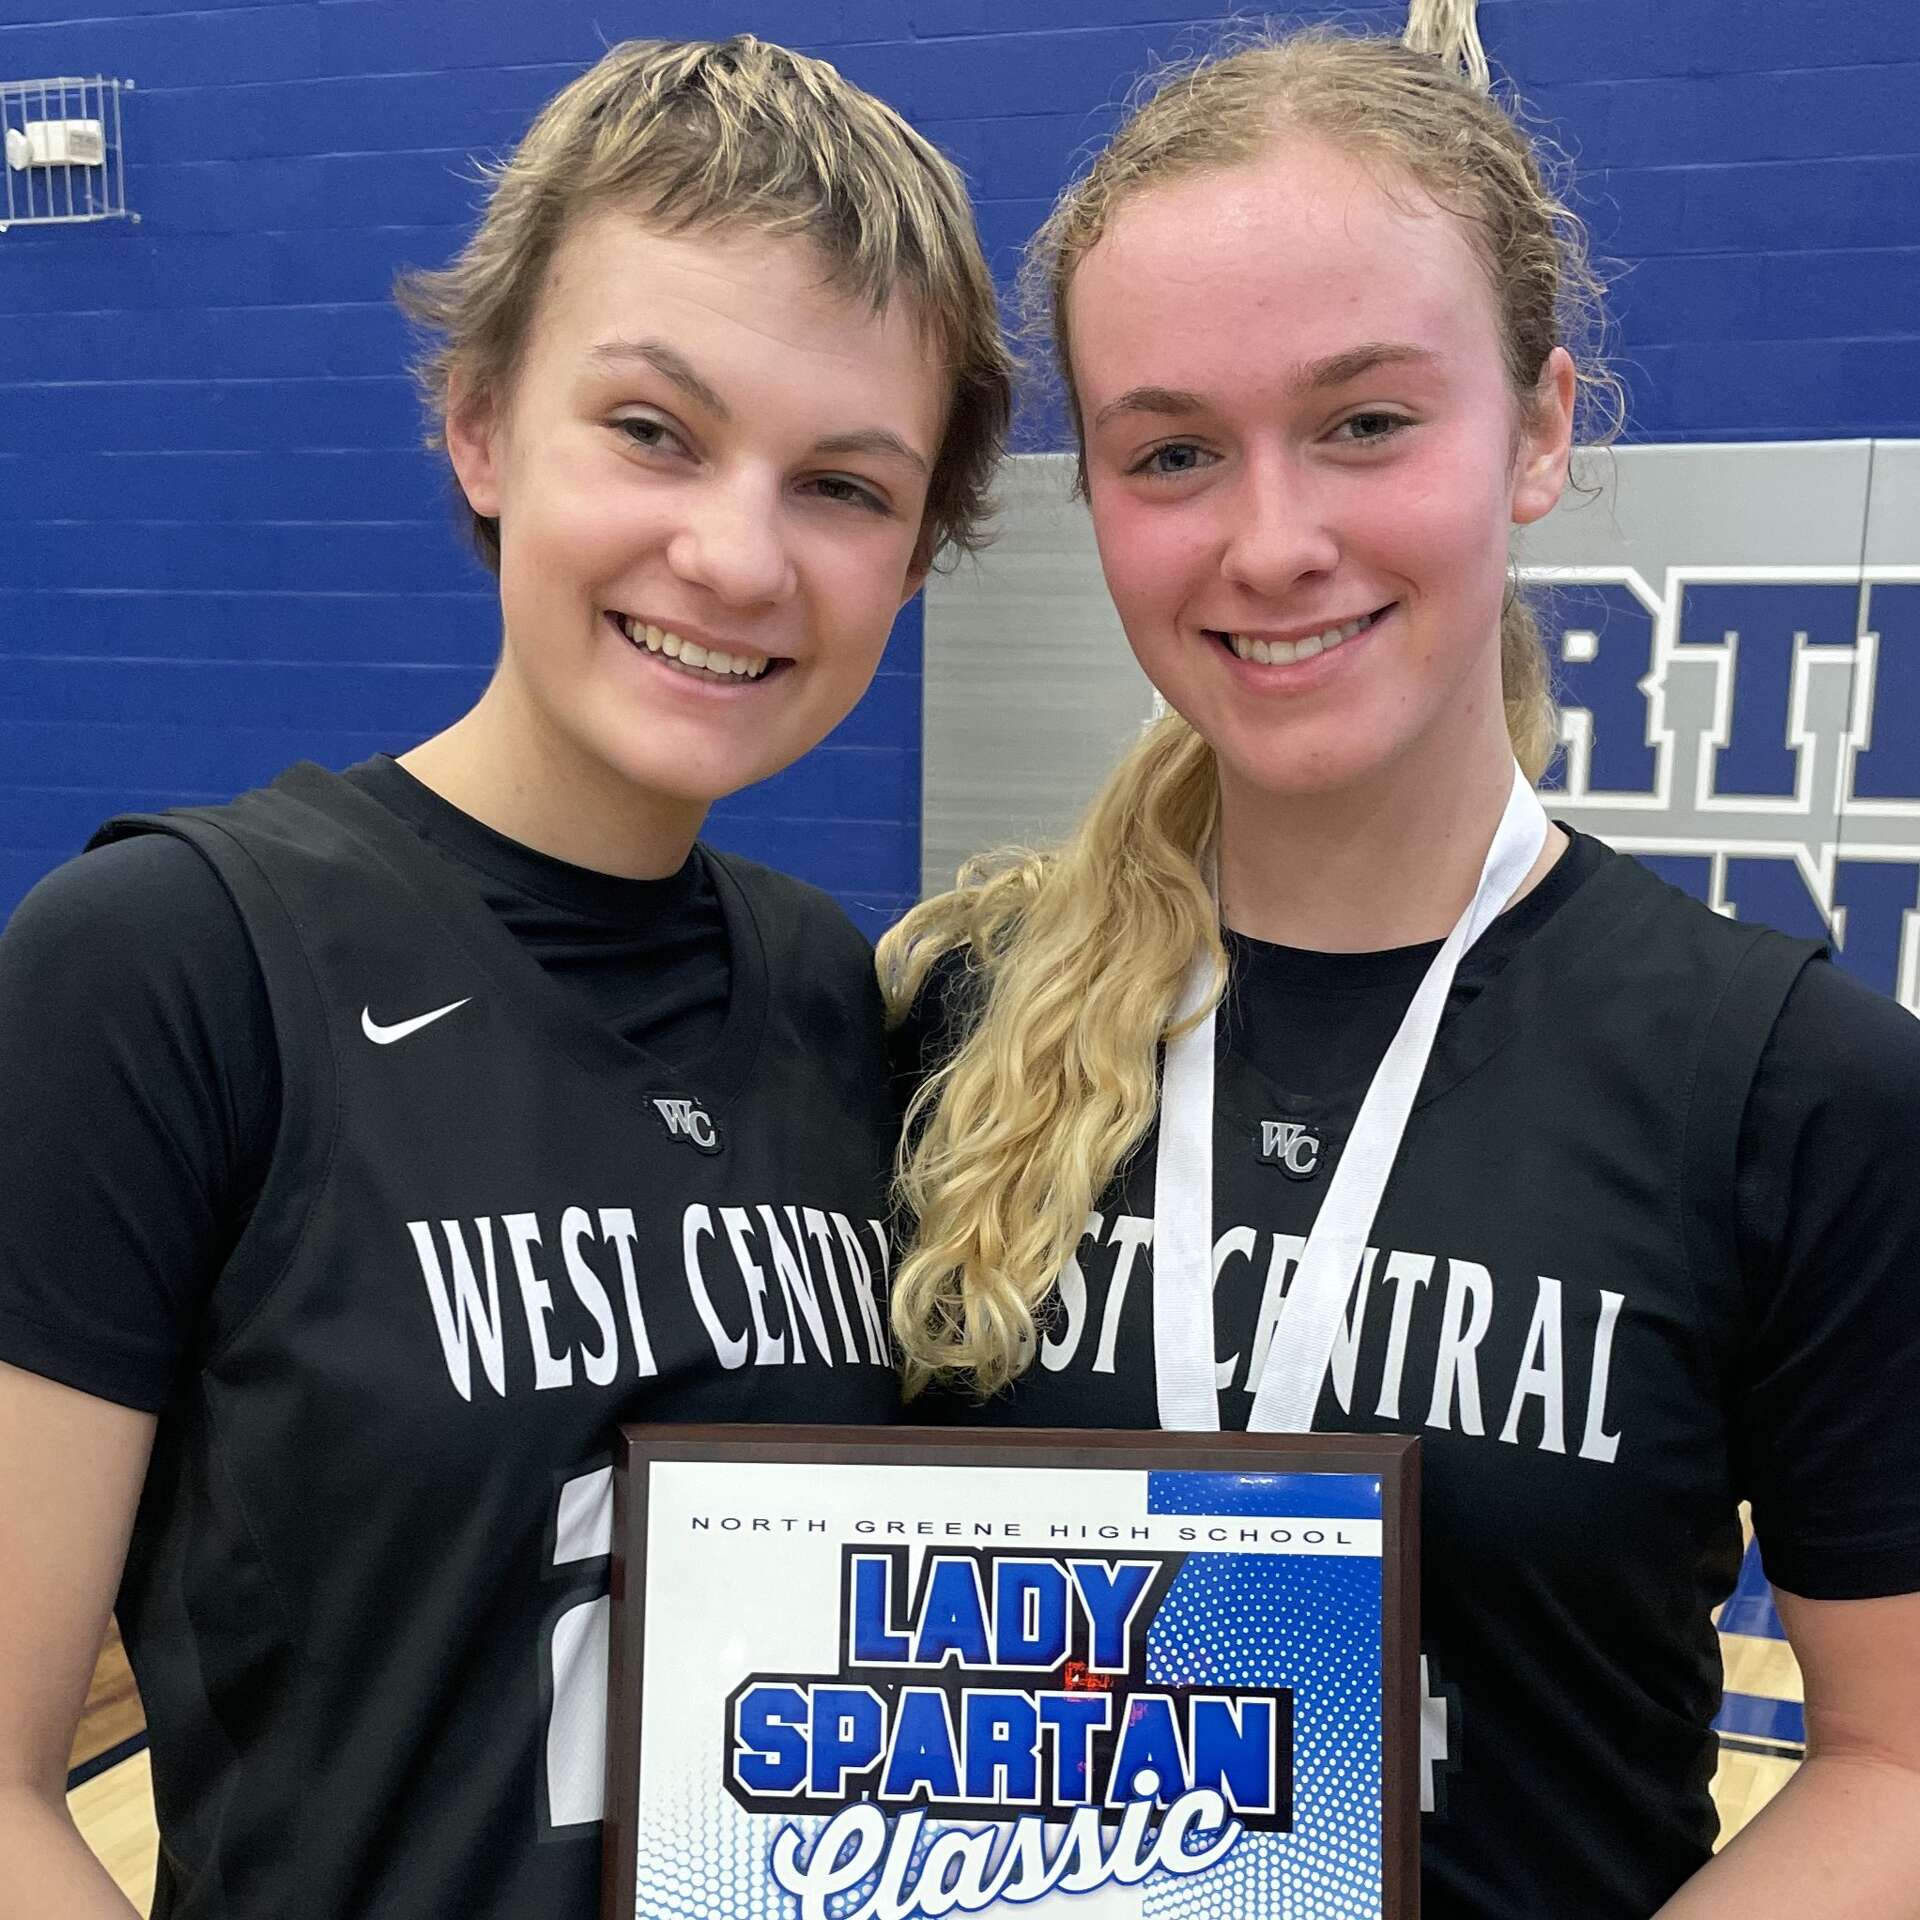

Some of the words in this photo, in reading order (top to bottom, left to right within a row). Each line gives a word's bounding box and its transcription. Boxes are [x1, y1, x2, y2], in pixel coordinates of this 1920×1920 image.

[653, 1099, 716, 1147] WC
[1260, 1120, 1320, 1173] WC
[406, 1206, 657, 1402] WEST
[682, 1203, 895, 1370] CENTR
[1041, 1211, 1154, 1374] ST
[691, 1516, 826, 1533] NORTH
[854, 1519, 1023, 1537] GREENE
[1049, 1524, 1150, 1540] HIGH
[1178, 1526, 1353, 1545] SCHOOL
[848, 1552, 1163, 1675] LADY
[732, 1681, 1277, 1814] SPARTAN
[771, 1766, 1245, 1920] Classic
